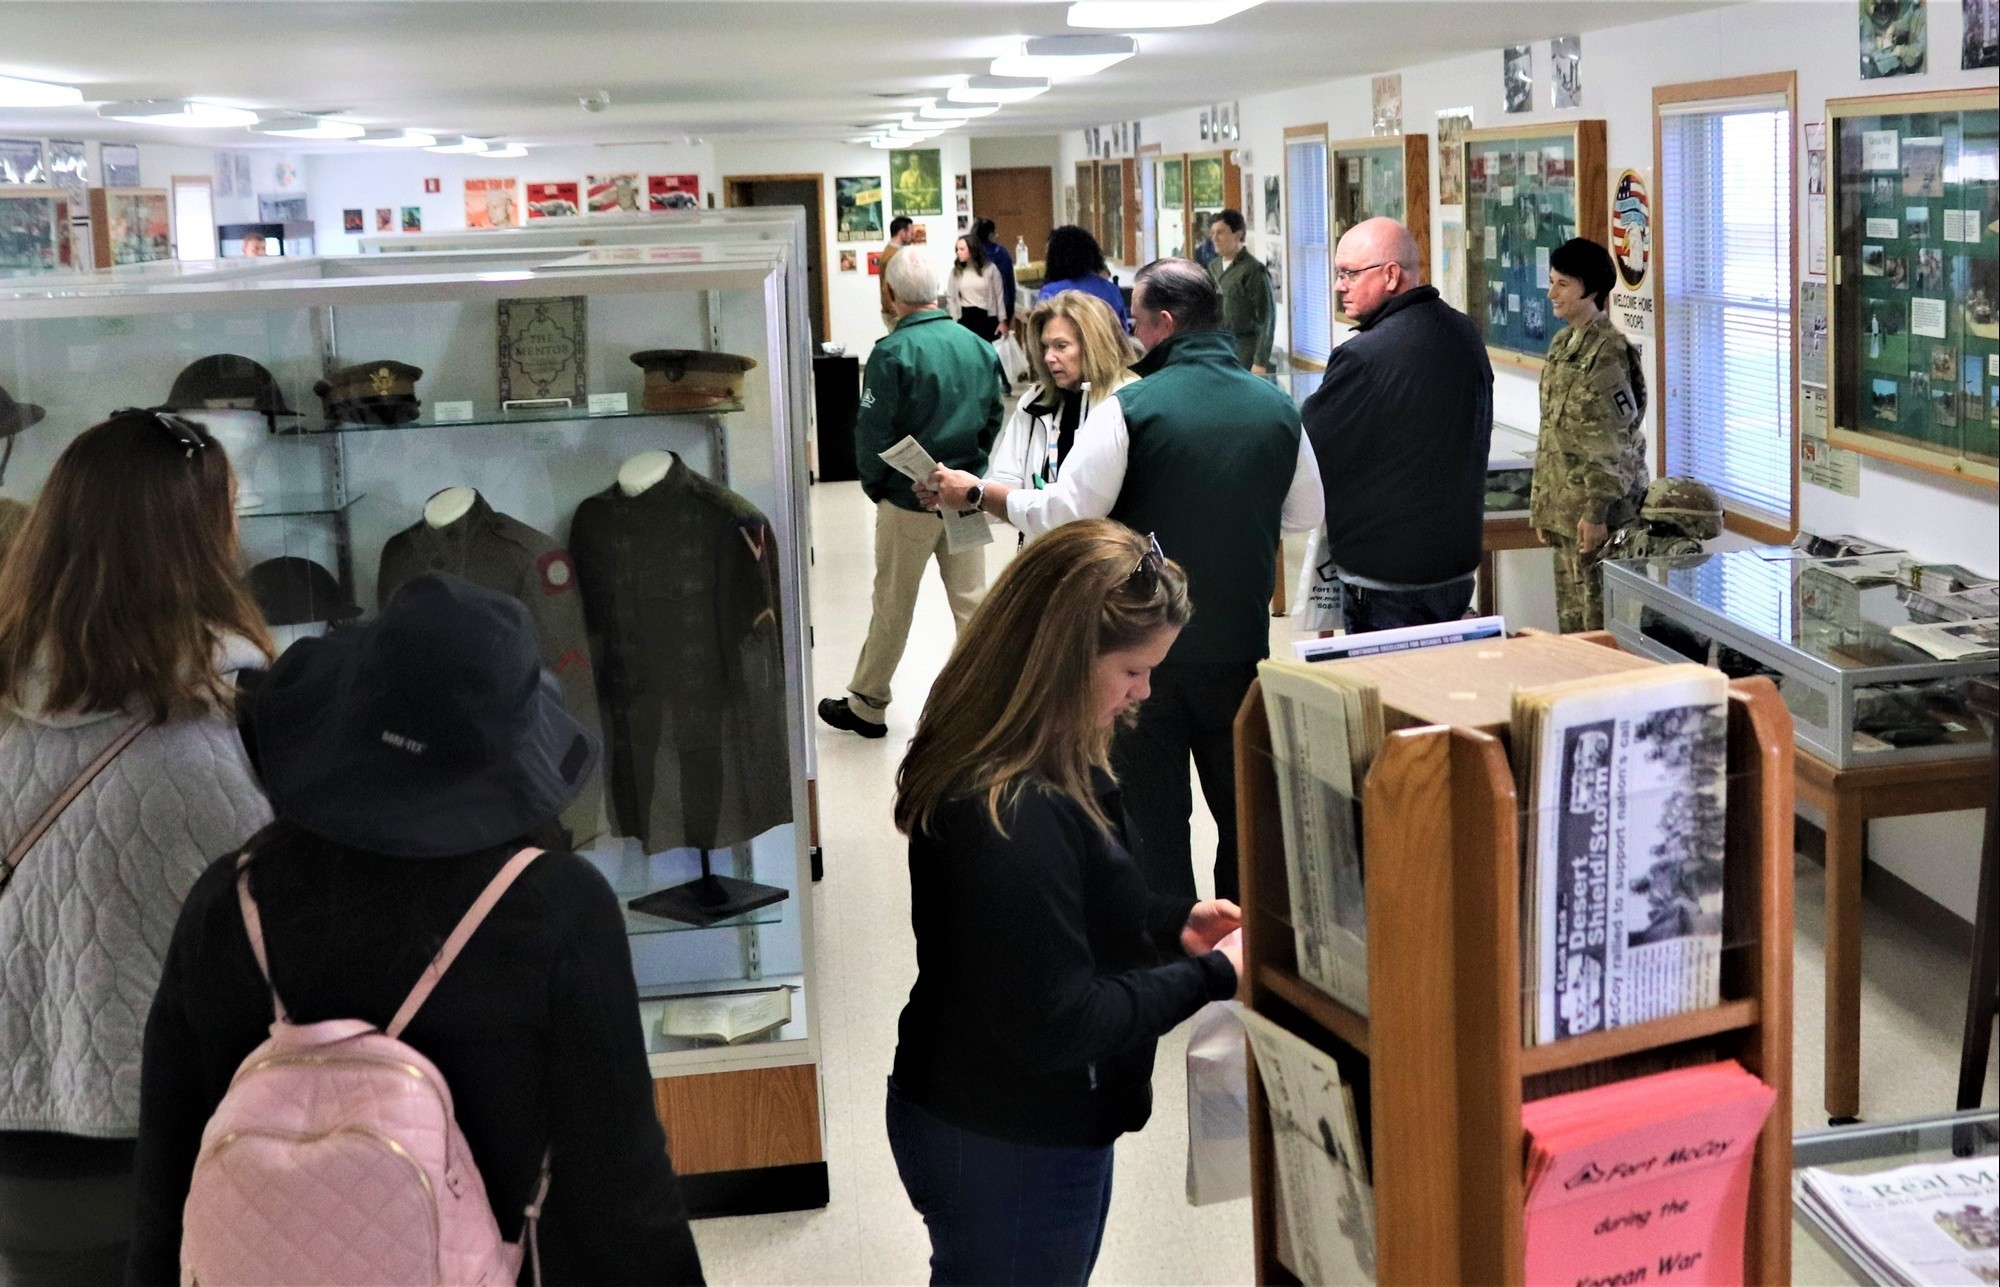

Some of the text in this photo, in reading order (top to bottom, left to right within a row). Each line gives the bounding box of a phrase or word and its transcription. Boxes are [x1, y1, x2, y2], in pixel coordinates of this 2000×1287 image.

[1612, 292, 1653, 313] WELCOME HOME
[1623, 313, 1645, 330] TROOPS
[514, 344, 569, 357] MENTOR
[529, 333, 553, 343] THE
[1619, 719, 1630, 748] call
[1617, 755, 1628, 820] nation's
[1587, 766, 1609, 946] Shield/Storm
[1615, 827, 1627, 890] support
[1570, 855, 1589, 950] Desert
[1613, 897, 1624, 914] to
[1558, 909, 1567, 944] Back
[1611, 920, 1623, 969] rallied
[1606, 1138, 1735, 1182] Fort McCoy
[1871, 1173, 1949, 1198] Real
[1956, 1169, 1999, 1187] M
[1594, 1196, 1690, 1236] during the
[1658, 1252, 1702, 1276] War
